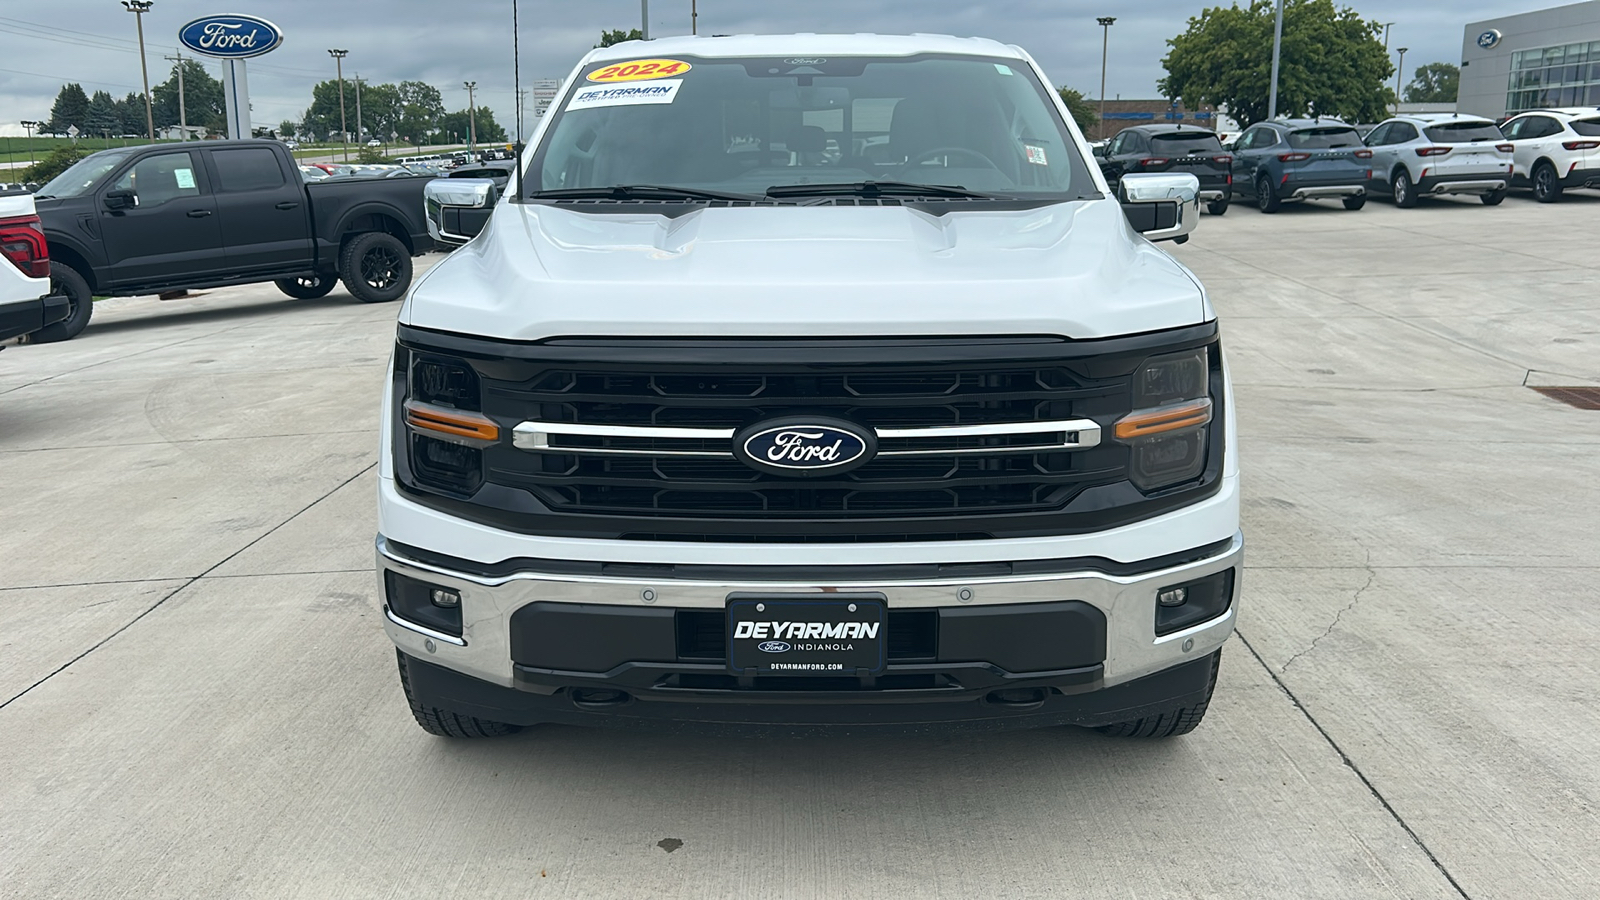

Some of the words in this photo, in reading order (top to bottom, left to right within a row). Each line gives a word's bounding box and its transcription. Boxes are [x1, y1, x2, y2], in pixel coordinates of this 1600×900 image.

[199, 22, 258, 48] Ford
[594, 62, 683, 80] 2024
[578, 86, 674, 100] DEYARMAN
[581, 95, 621, 103] CERTIFIED
[767, 431, 843, 461] Ford
[733, 621, 880, 639] DEYARMAN
[764, 642, 784, 651] Ford
[793, 643, 854, 651] INDIANOLA
